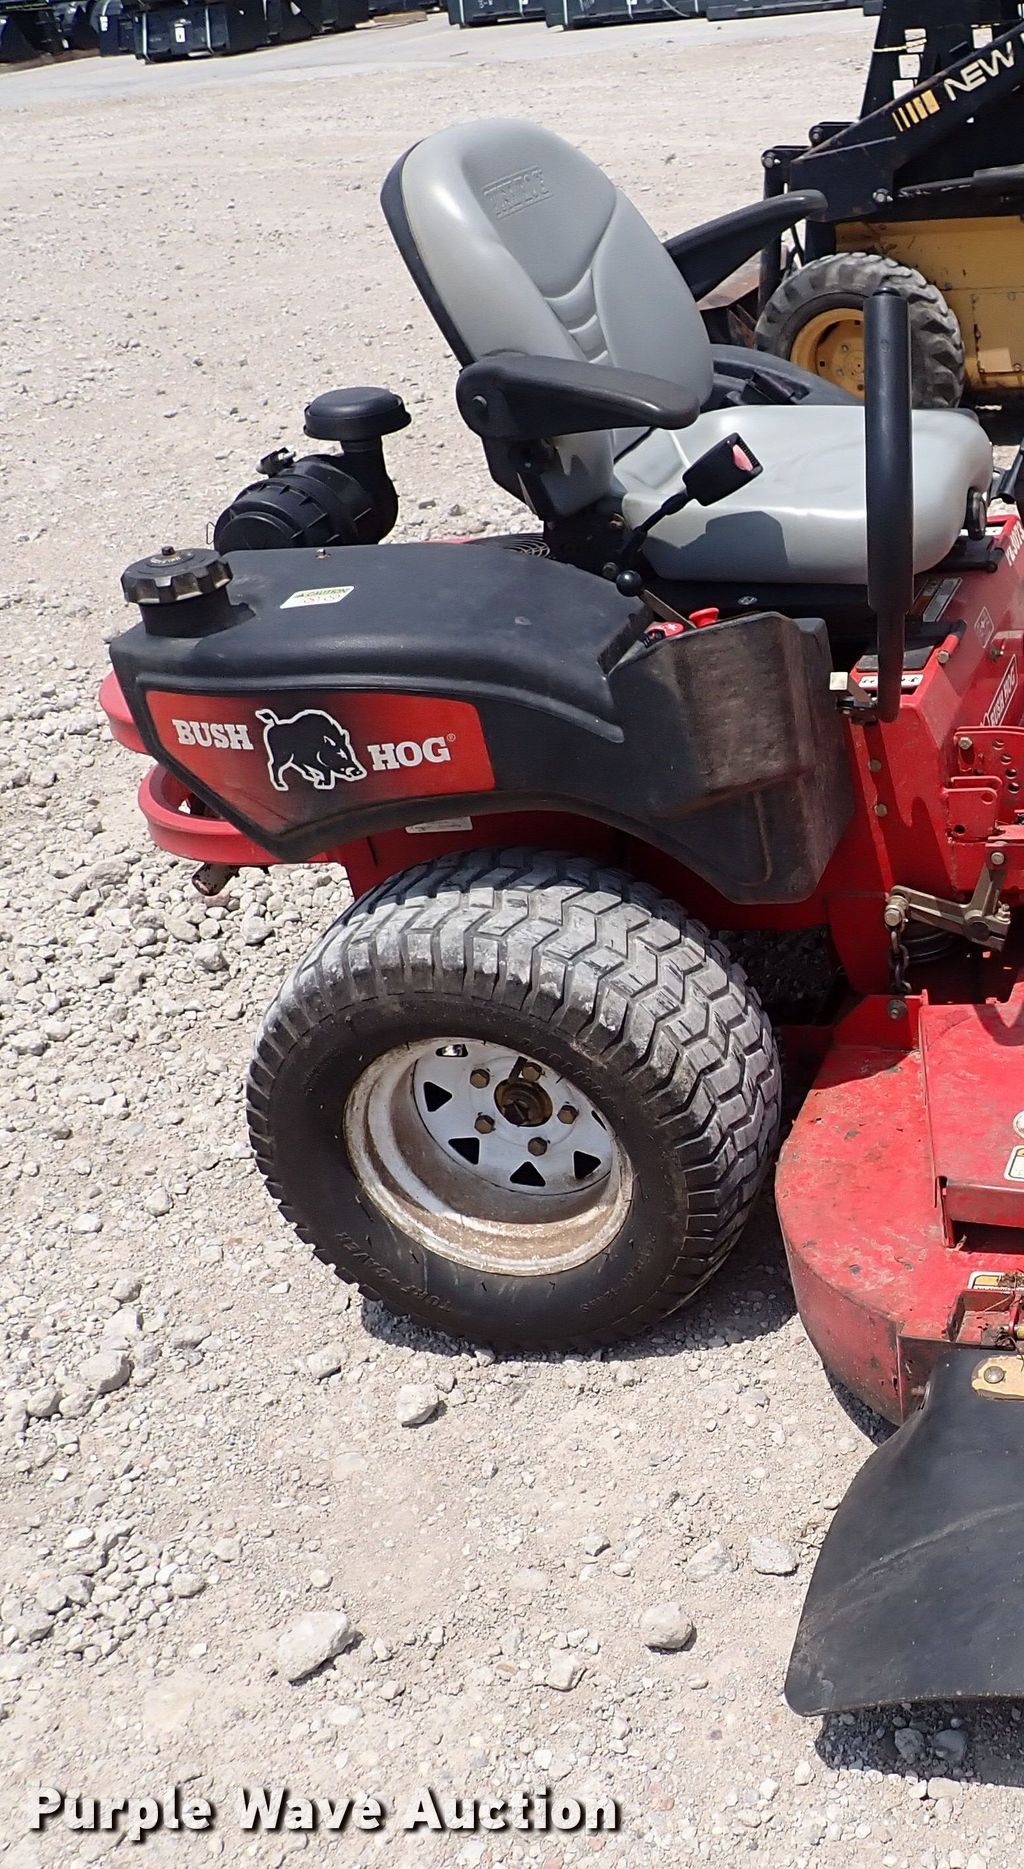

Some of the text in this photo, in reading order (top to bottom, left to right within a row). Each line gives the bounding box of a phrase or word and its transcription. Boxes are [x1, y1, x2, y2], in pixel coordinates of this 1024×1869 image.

[943, 40, 1015, 102] NEW
[171, 718, 452, 771] BUSH HOG
